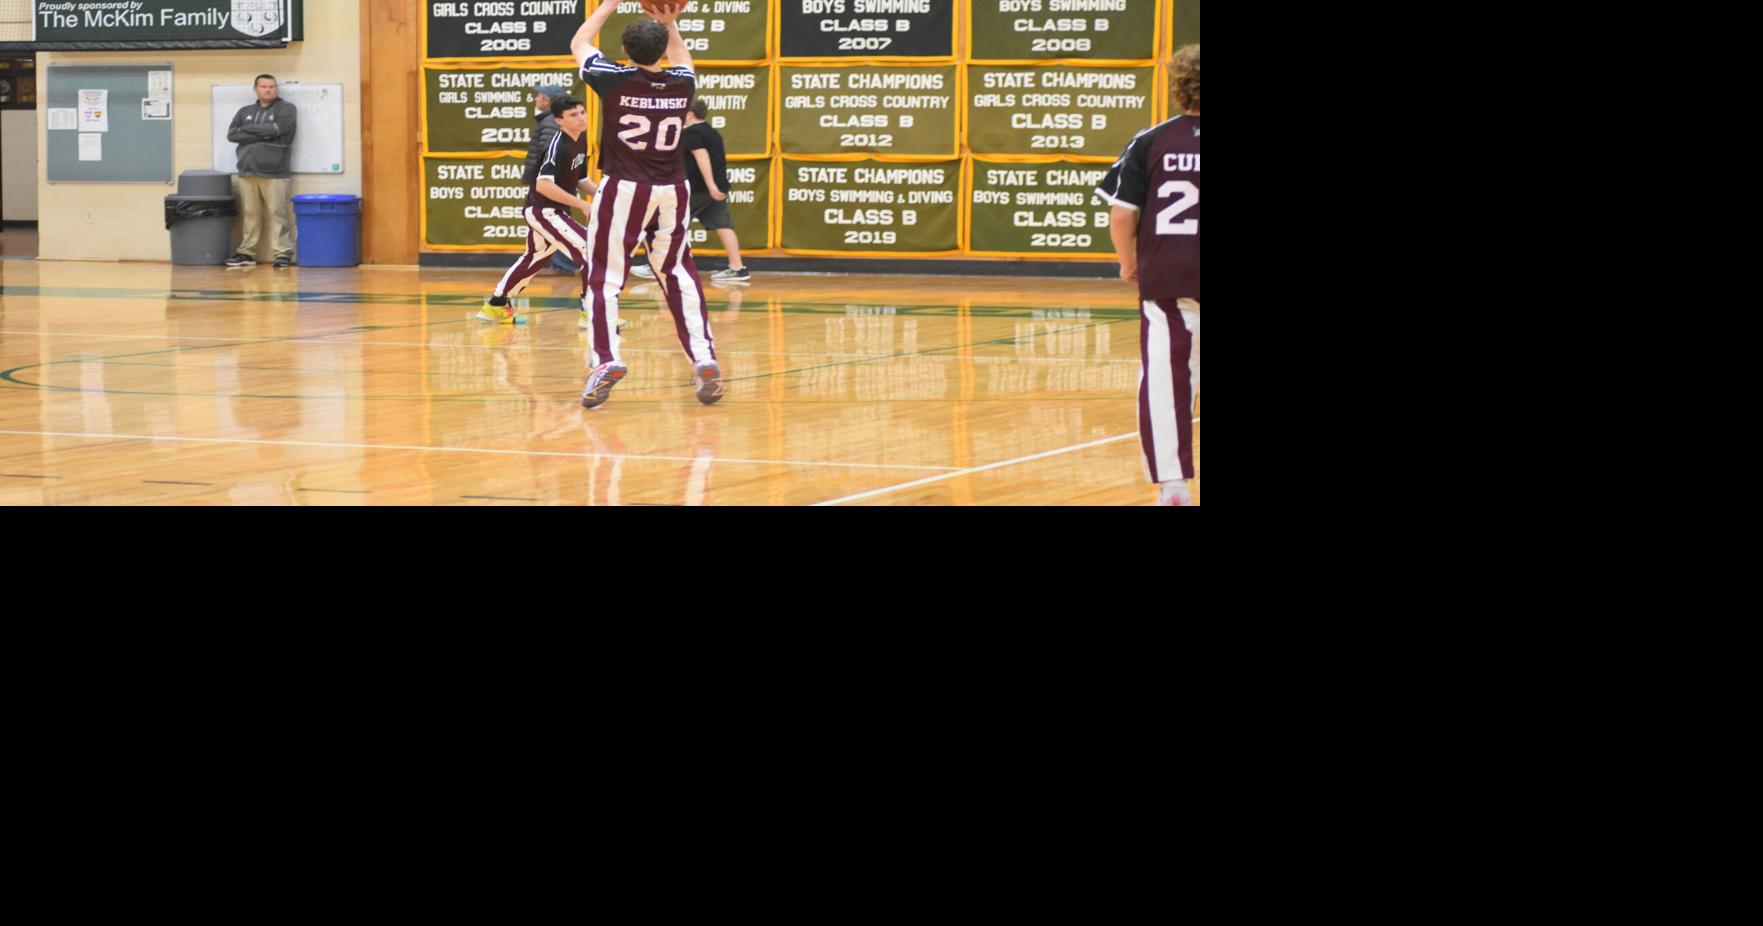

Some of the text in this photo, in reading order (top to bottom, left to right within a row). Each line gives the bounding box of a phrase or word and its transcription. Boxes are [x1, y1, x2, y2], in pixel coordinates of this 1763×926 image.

[38, 1, 143, 12] Proudly sponsored by
[433, 0, 578, 17] GIRLS CROSS COUNTRY
[702, 4, 710, 13] &
[714, 1, 751, 13] DIVING
[802, 0, 930, 14] BOYS SWIMMING
[999, 0, 1126, 12] BOYS SWIMMING
[39, 8, 230, 29] The McKim Family
[1014, 18, 1110, 31] CLASS B
[464, 21, 547, 34] CLASS B
[710, 20, 725, 32] B
[820, 19, 910, 32] CLASS B
[480, 38, 531, 51] 2006
[838, 37, 892, 50] 2007
[1032, 38, 1091, 51] 2008
[438, 73, 574, 88] STATE CHAMPIONS
[791, 73, 944, 89] STATE CHAMPIONS
[984, 72, 1136, 89] STATE CHAMPIONS
[438, 91, 533, 104] GIRLS SWIMMING &
[620, 96, 688, 109] KEBLINSKI
[785, 95, 950, 109] GIRLS CROSS COUNTRY
[974, 94, 1145, 109] GIRLS CROSS COUNTRY
[464, 107, 527, 119] CLASS
[711, 116, 726, 128] B
[819, 115, 914, 127] CLASS B
[1011, 113, 1107, 130] CLASS B
[481, 128, 531, 142] 2011
[617, 114, 682, 151] 20
[840, 134, 893, 147] 2012
[1030, 135, 1085, 148] 2013
[438, 165, 484, 180] STATE
[798, 167, 944, 184] STATE CHAMPIONS
[986, 170, 1038, 186] STATE
[430, 187, 464, 200] BOYS
[788, 188, 953, 203] BOYS SWIMMING & DIVING
[973, 190, 1101, 206] BOYS SWIMMING &
[464, 206, 524, 219] CLASS
[824, 208, 917, 225] CLASS B
[1013, 211, 1109, 228] CLASS B
[483, 225, 529, 238] 2018
[844, 231, 896, 244] 2019
[1031, 234, 1092, 247] 2020
